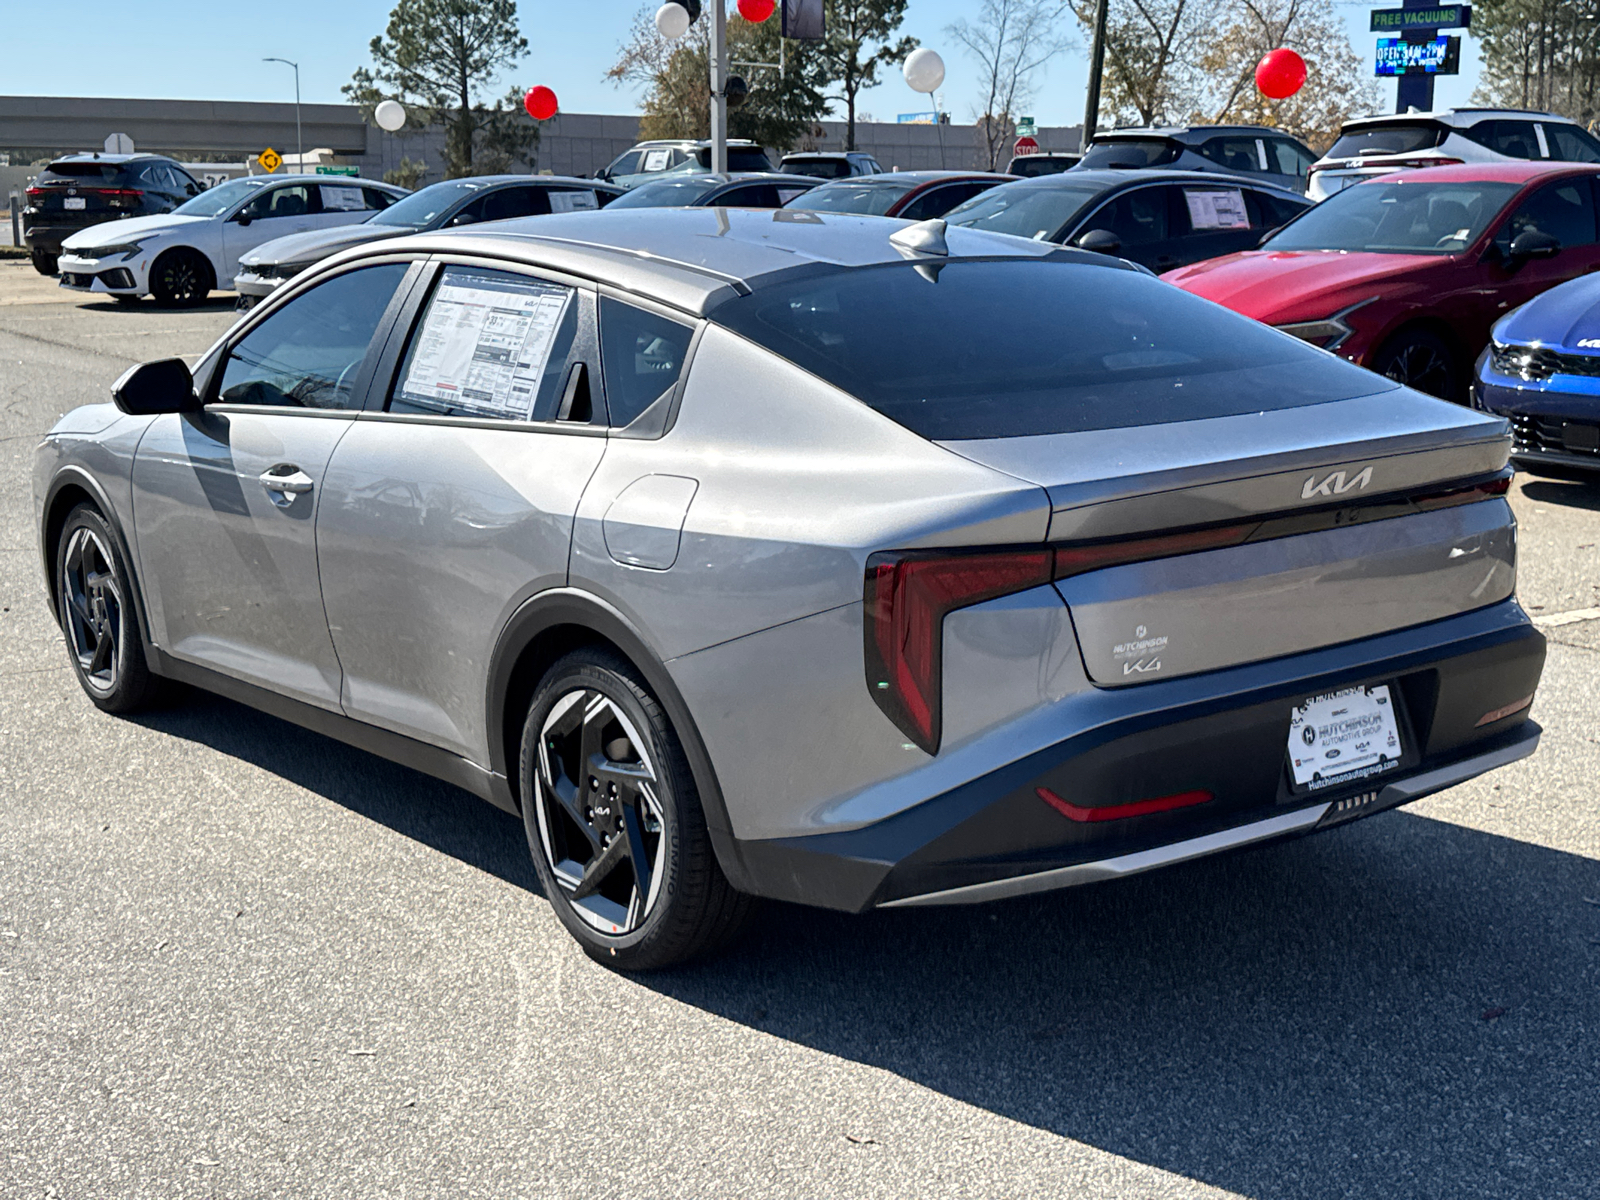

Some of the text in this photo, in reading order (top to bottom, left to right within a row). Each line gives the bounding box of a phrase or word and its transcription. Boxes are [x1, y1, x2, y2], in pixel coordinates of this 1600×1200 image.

[1374, 9, 1456, 26] FREE VACUUMS
[1016, 145, 1038, 156] STOP
[1301, 466, 1373, 499] KIA
[1113, 636, 1168, 653] HUTCHINSON
[1123, 656, 1161, 675] K4
[1318, 711, 1382, 739] HUTCHINSON
[1322, 725, 1381, 746] AUTOMOTIVE GROUP
[594, 806, 611, 815] KIA
[668, 820, 680, 896] KUMHO
